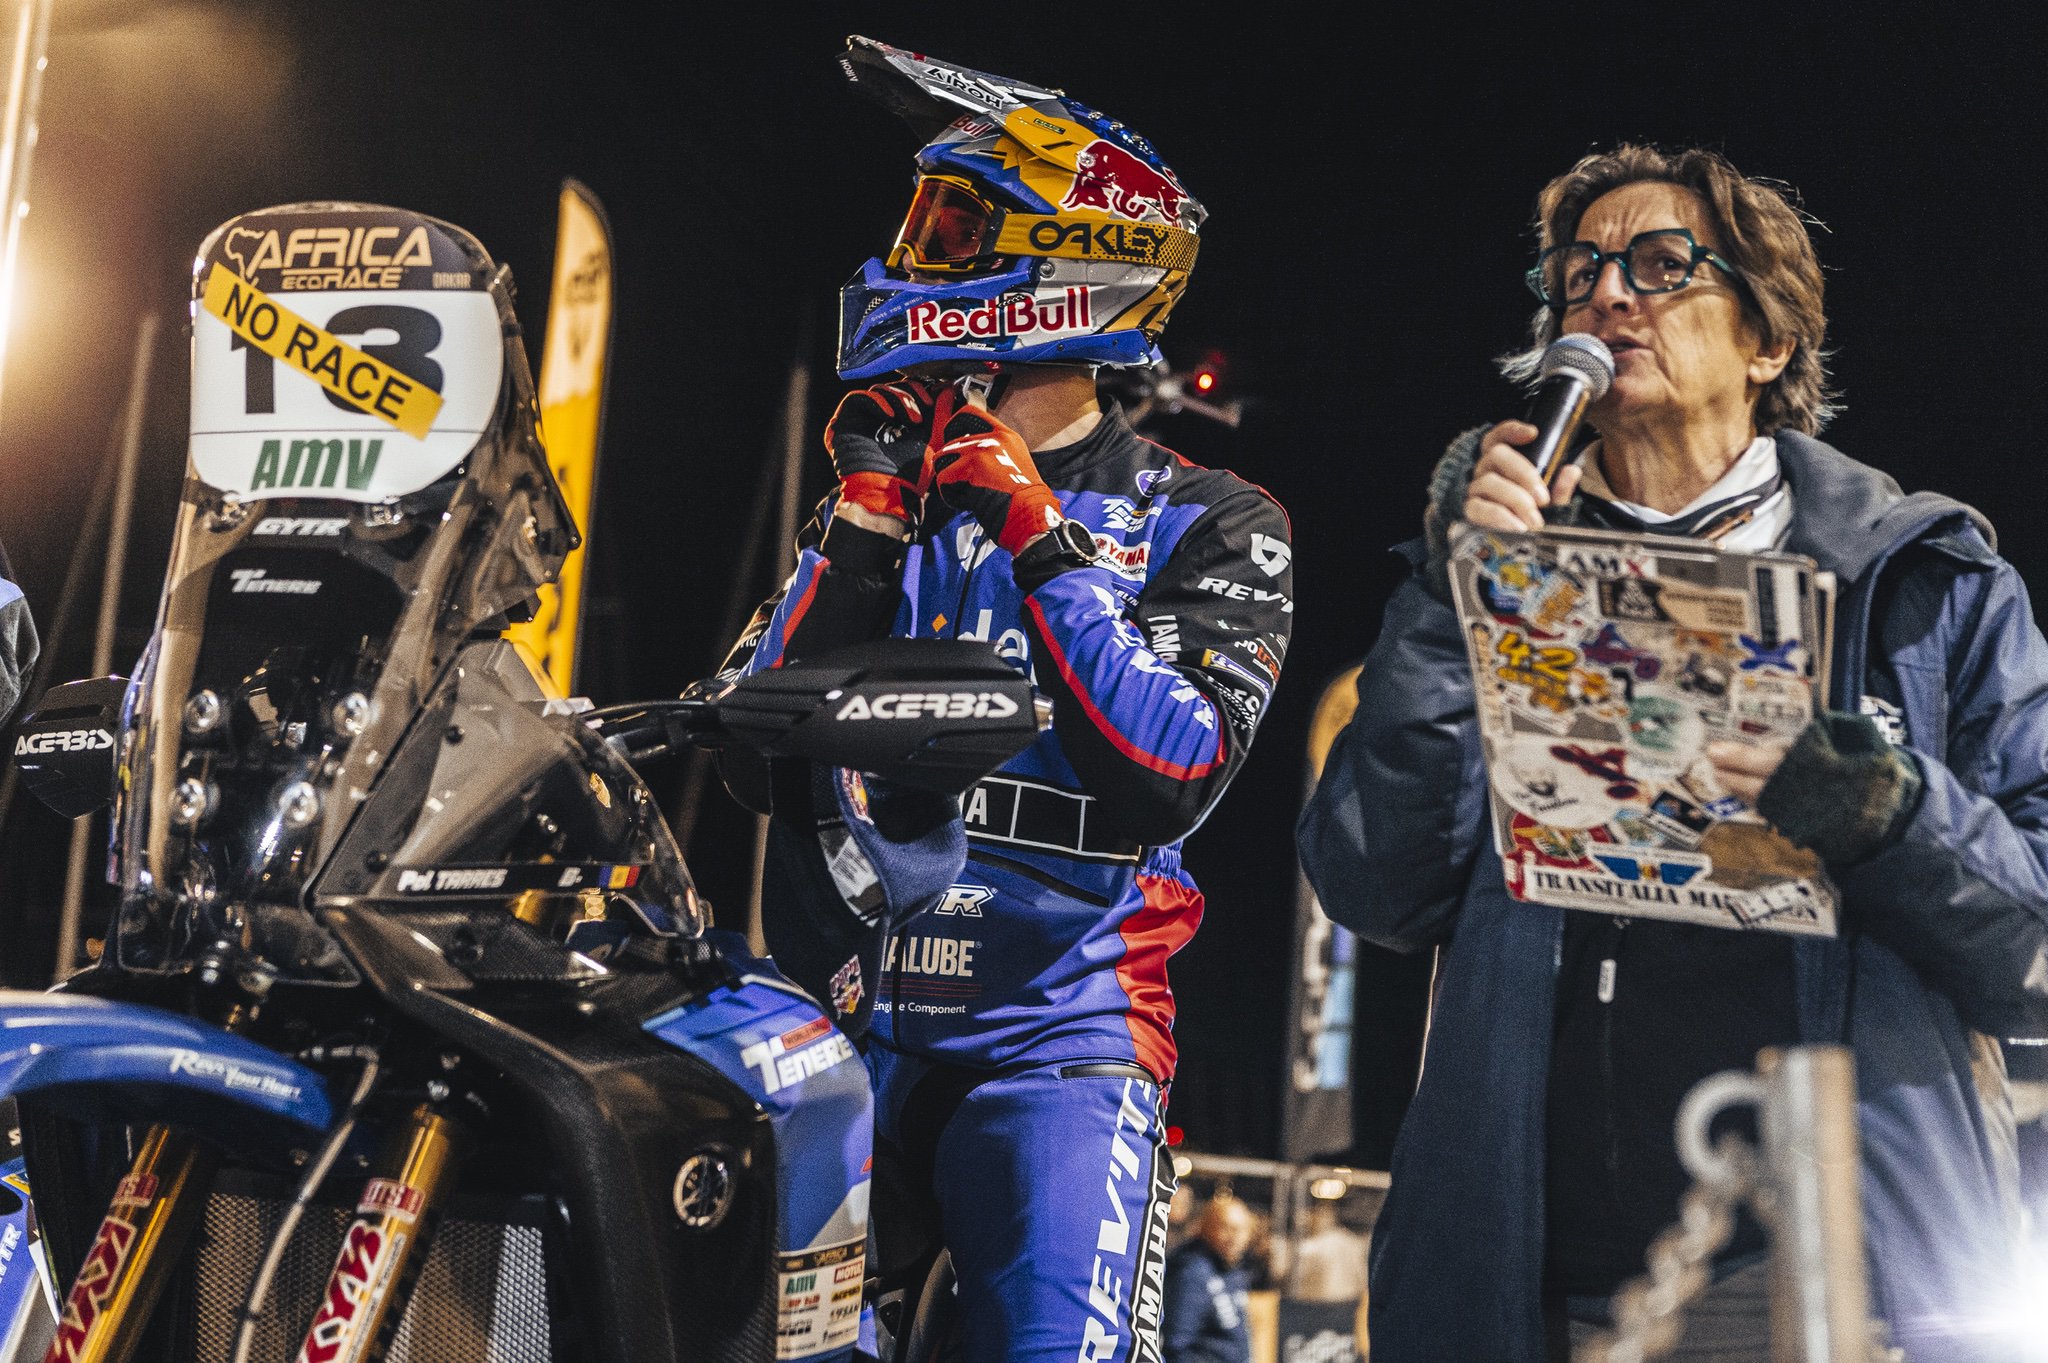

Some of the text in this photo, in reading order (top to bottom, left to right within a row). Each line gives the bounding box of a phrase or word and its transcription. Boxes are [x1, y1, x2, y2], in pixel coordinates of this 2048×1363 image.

[927, 67, 1003, 109] AIROH
[952, 114, 995, 138] Bull
[246, 226, 433, 277] AFRICA
[1029, 220, 1168, 258] OAKLEY
[909, 285, 1090, 341] Red Bull
[223, 285, 413, 421] NO RACE
[250, 438, 385, 491] AMV
[252, 517, 351, 536] GYTR
[1108, 543, 1151, 567] YAMA
[1115, 589, 1139, 607] ELIN
[836, 692, 1019, 719] ACERBIS
[14, 728, 115, 756] ACERBIS
[880, 935, 976, 977] ALUBE
[873, 1001, 966, 1016] Engie Component
